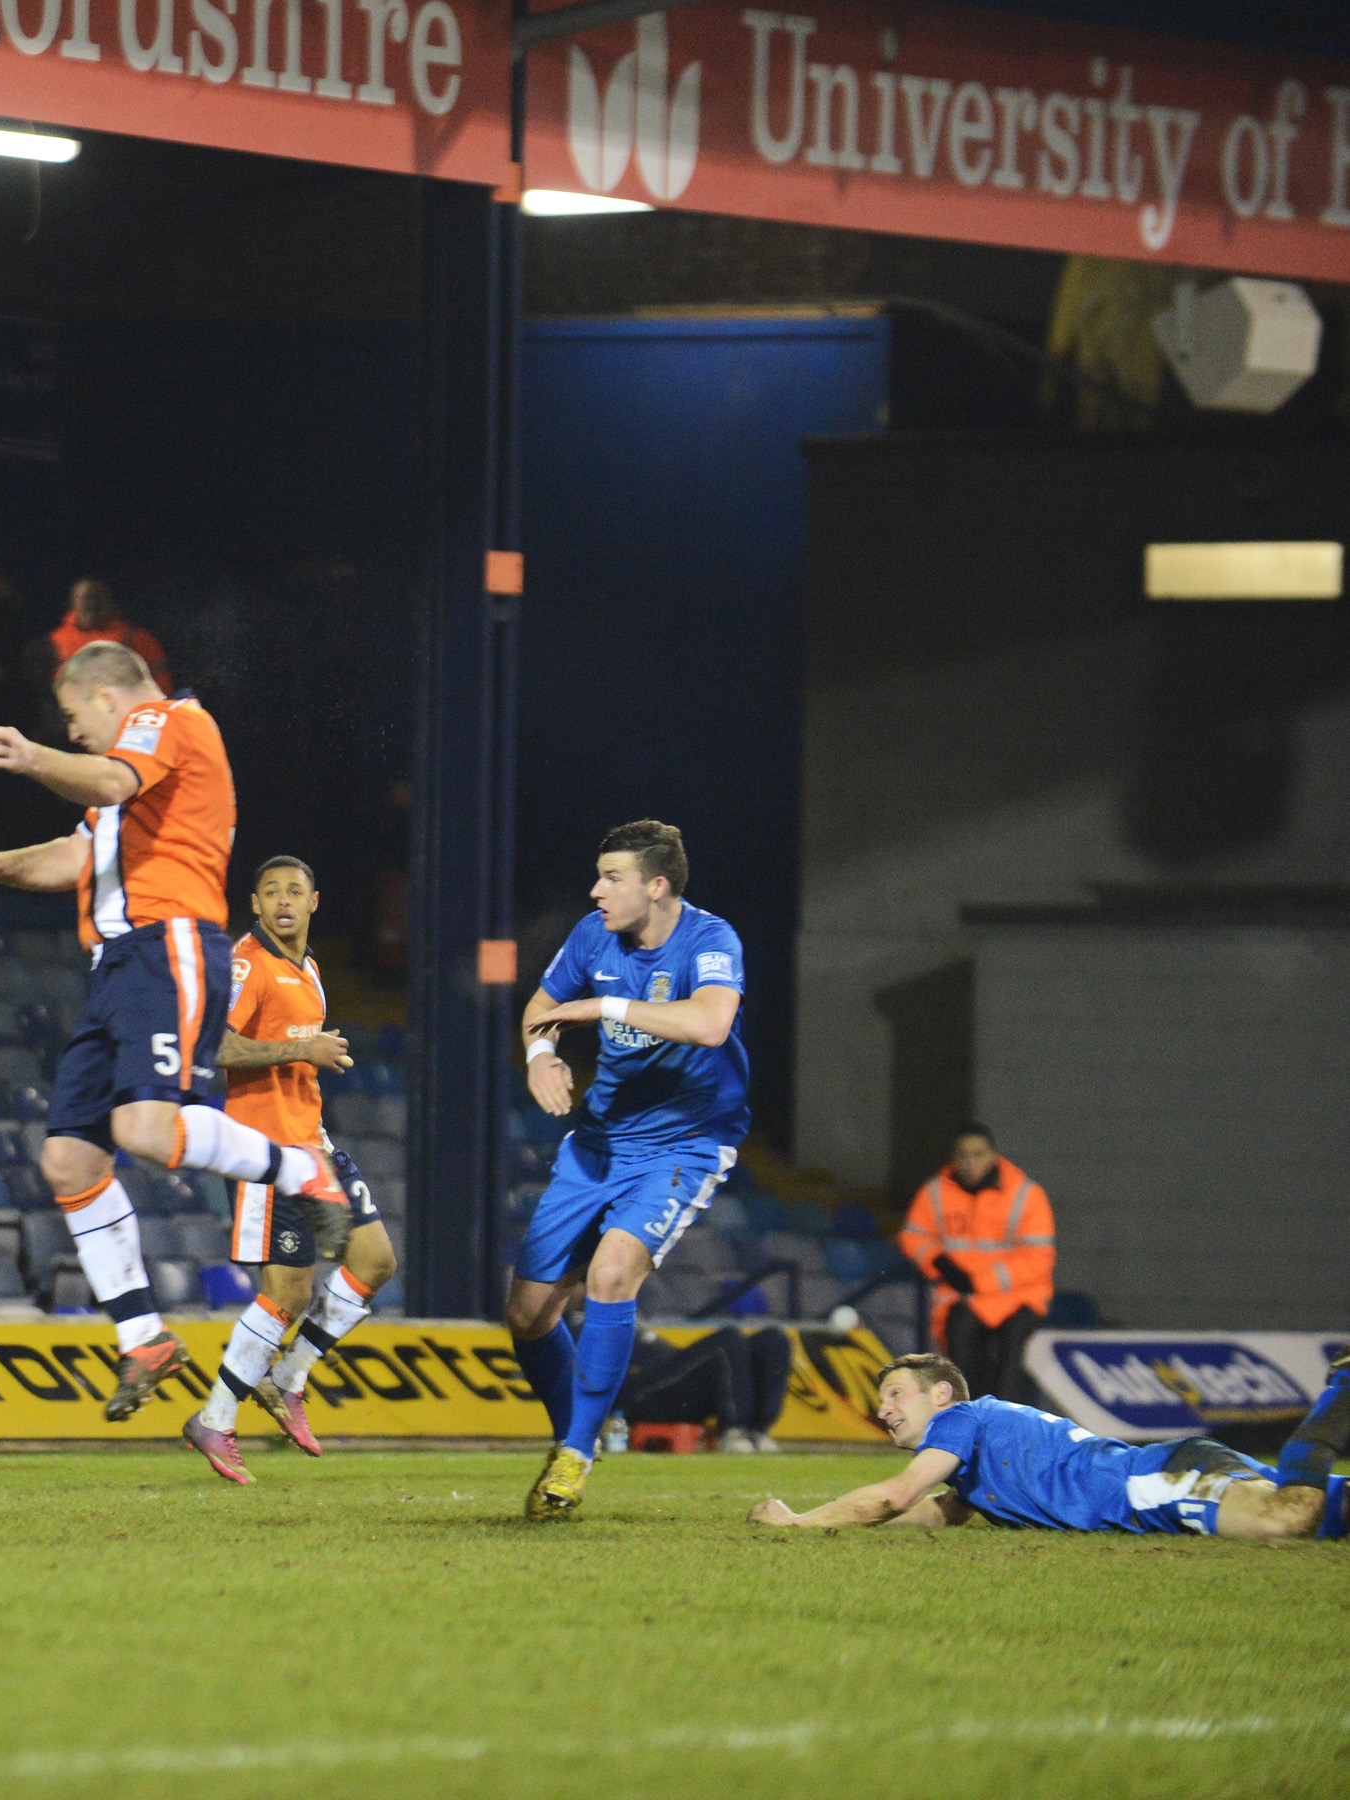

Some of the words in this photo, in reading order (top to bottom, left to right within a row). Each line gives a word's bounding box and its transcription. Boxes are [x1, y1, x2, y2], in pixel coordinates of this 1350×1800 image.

[744, 8, 1200, 251] University
[1222, 80, 1287, 220] of
[151, 1032, 181, 1076] 5
[222, 1336, 536, 1408] ports
